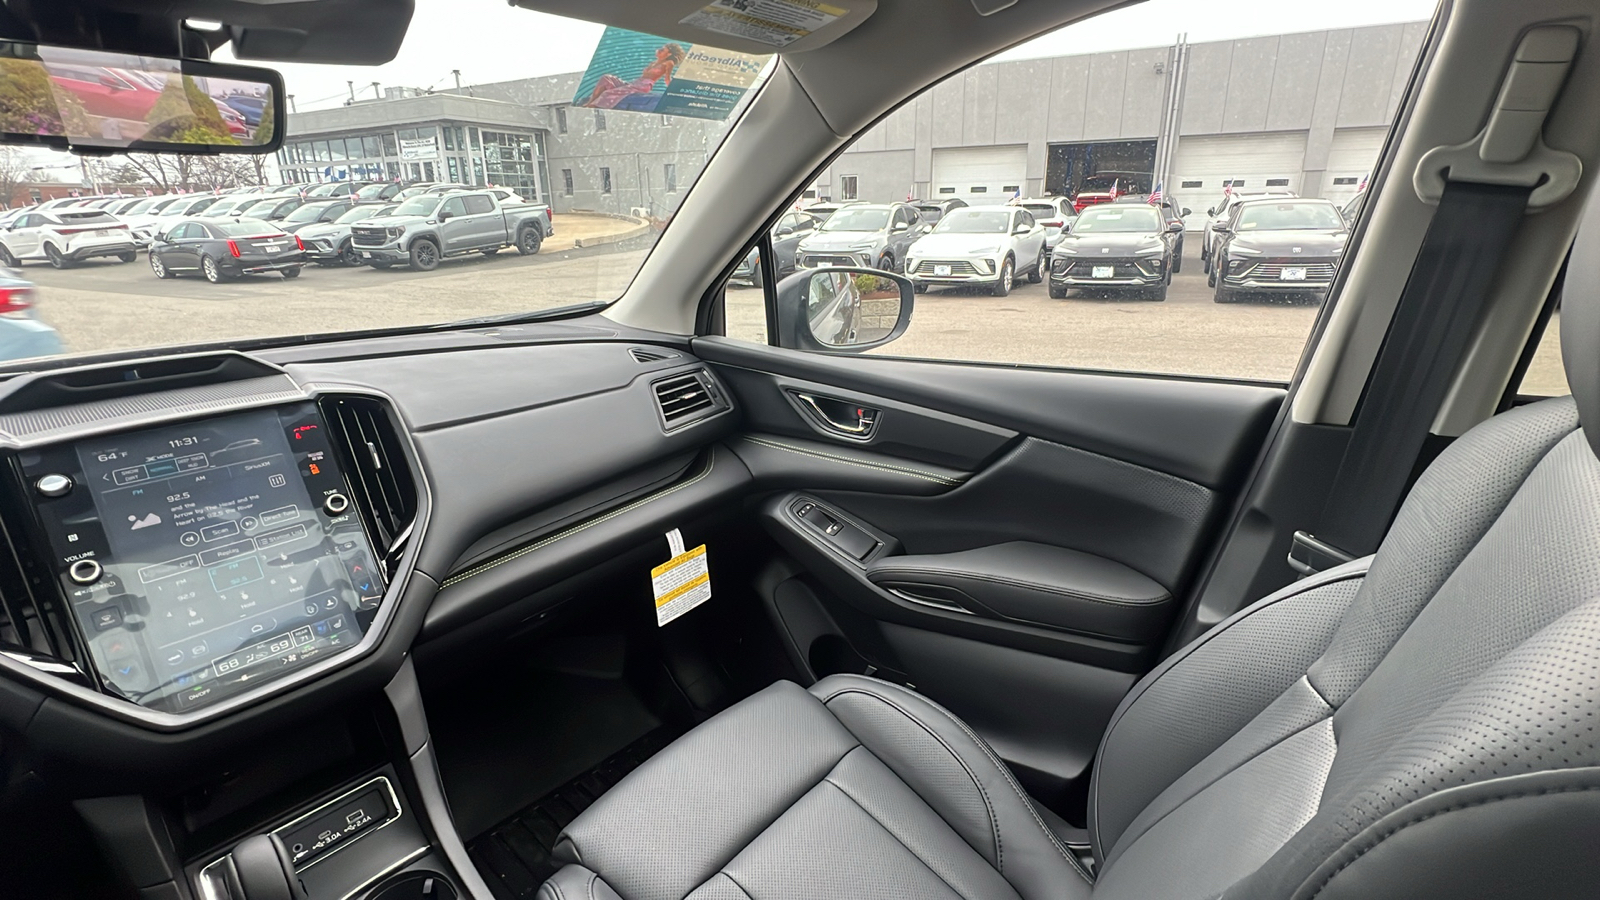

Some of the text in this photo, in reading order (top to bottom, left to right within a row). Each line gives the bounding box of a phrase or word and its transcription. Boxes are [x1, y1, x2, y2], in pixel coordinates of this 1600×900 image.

[168, 436, 198, 448] 11:31
[98, 452, 118, 462] 64
[166, 492, 190, 502] 92.5
[174, 510, 193, 519] Arrow
[64, 550, 96, 562] VOLUME
[270, 640, 289, 652] 69
[219, 658, 240, 672] 68
[188, 688, 211, 700] ON/OFF
[356, 816, 372, 826] 2.4A
[325, 832, 342, 844] 3.0A
